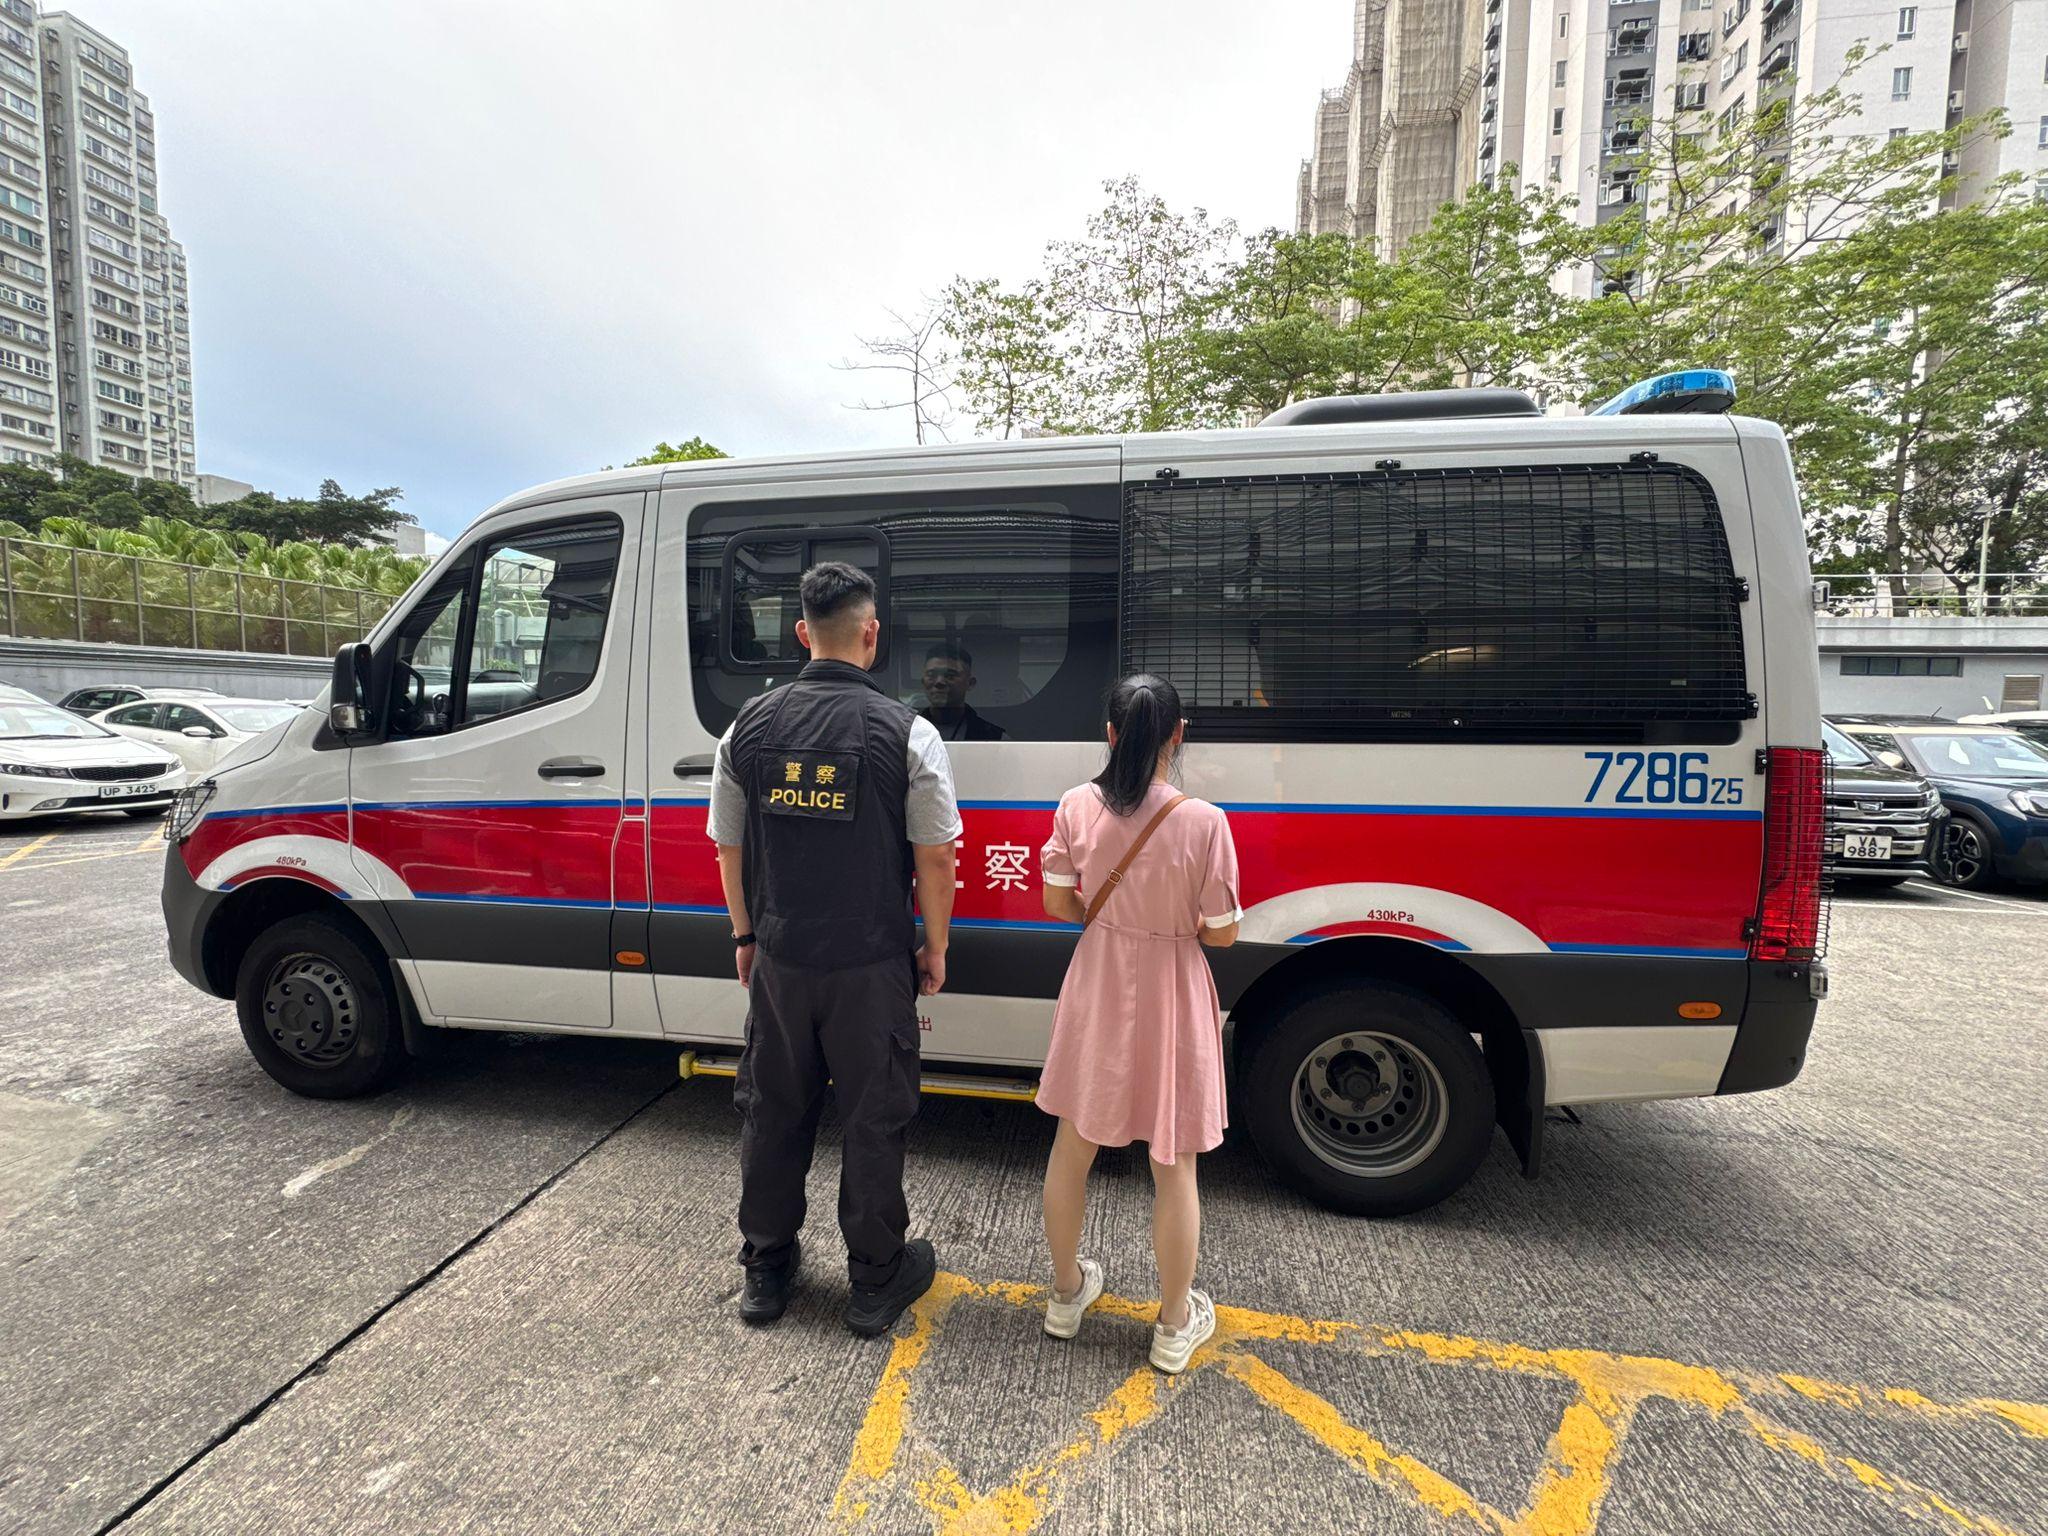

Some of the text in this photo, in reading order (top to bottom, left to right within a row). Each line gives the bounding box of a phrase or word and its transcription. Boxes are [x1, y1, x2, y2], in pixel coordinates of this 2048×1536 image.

[785, 761, 836, 784] 警察
[1584, 752, 1744, 804] 7286 25
[103, 784, 156, 796] UP 3425
[770, 788, 846, 809] POLICE
[1859, 836, 1877, 847] VA
[1847, 846, 1888, 858] 9887
[275, 856, 307, 866] 480kPa
[985, 840, 1031, 892] 察
[1367, 909, 1415, 922] 430kPa
